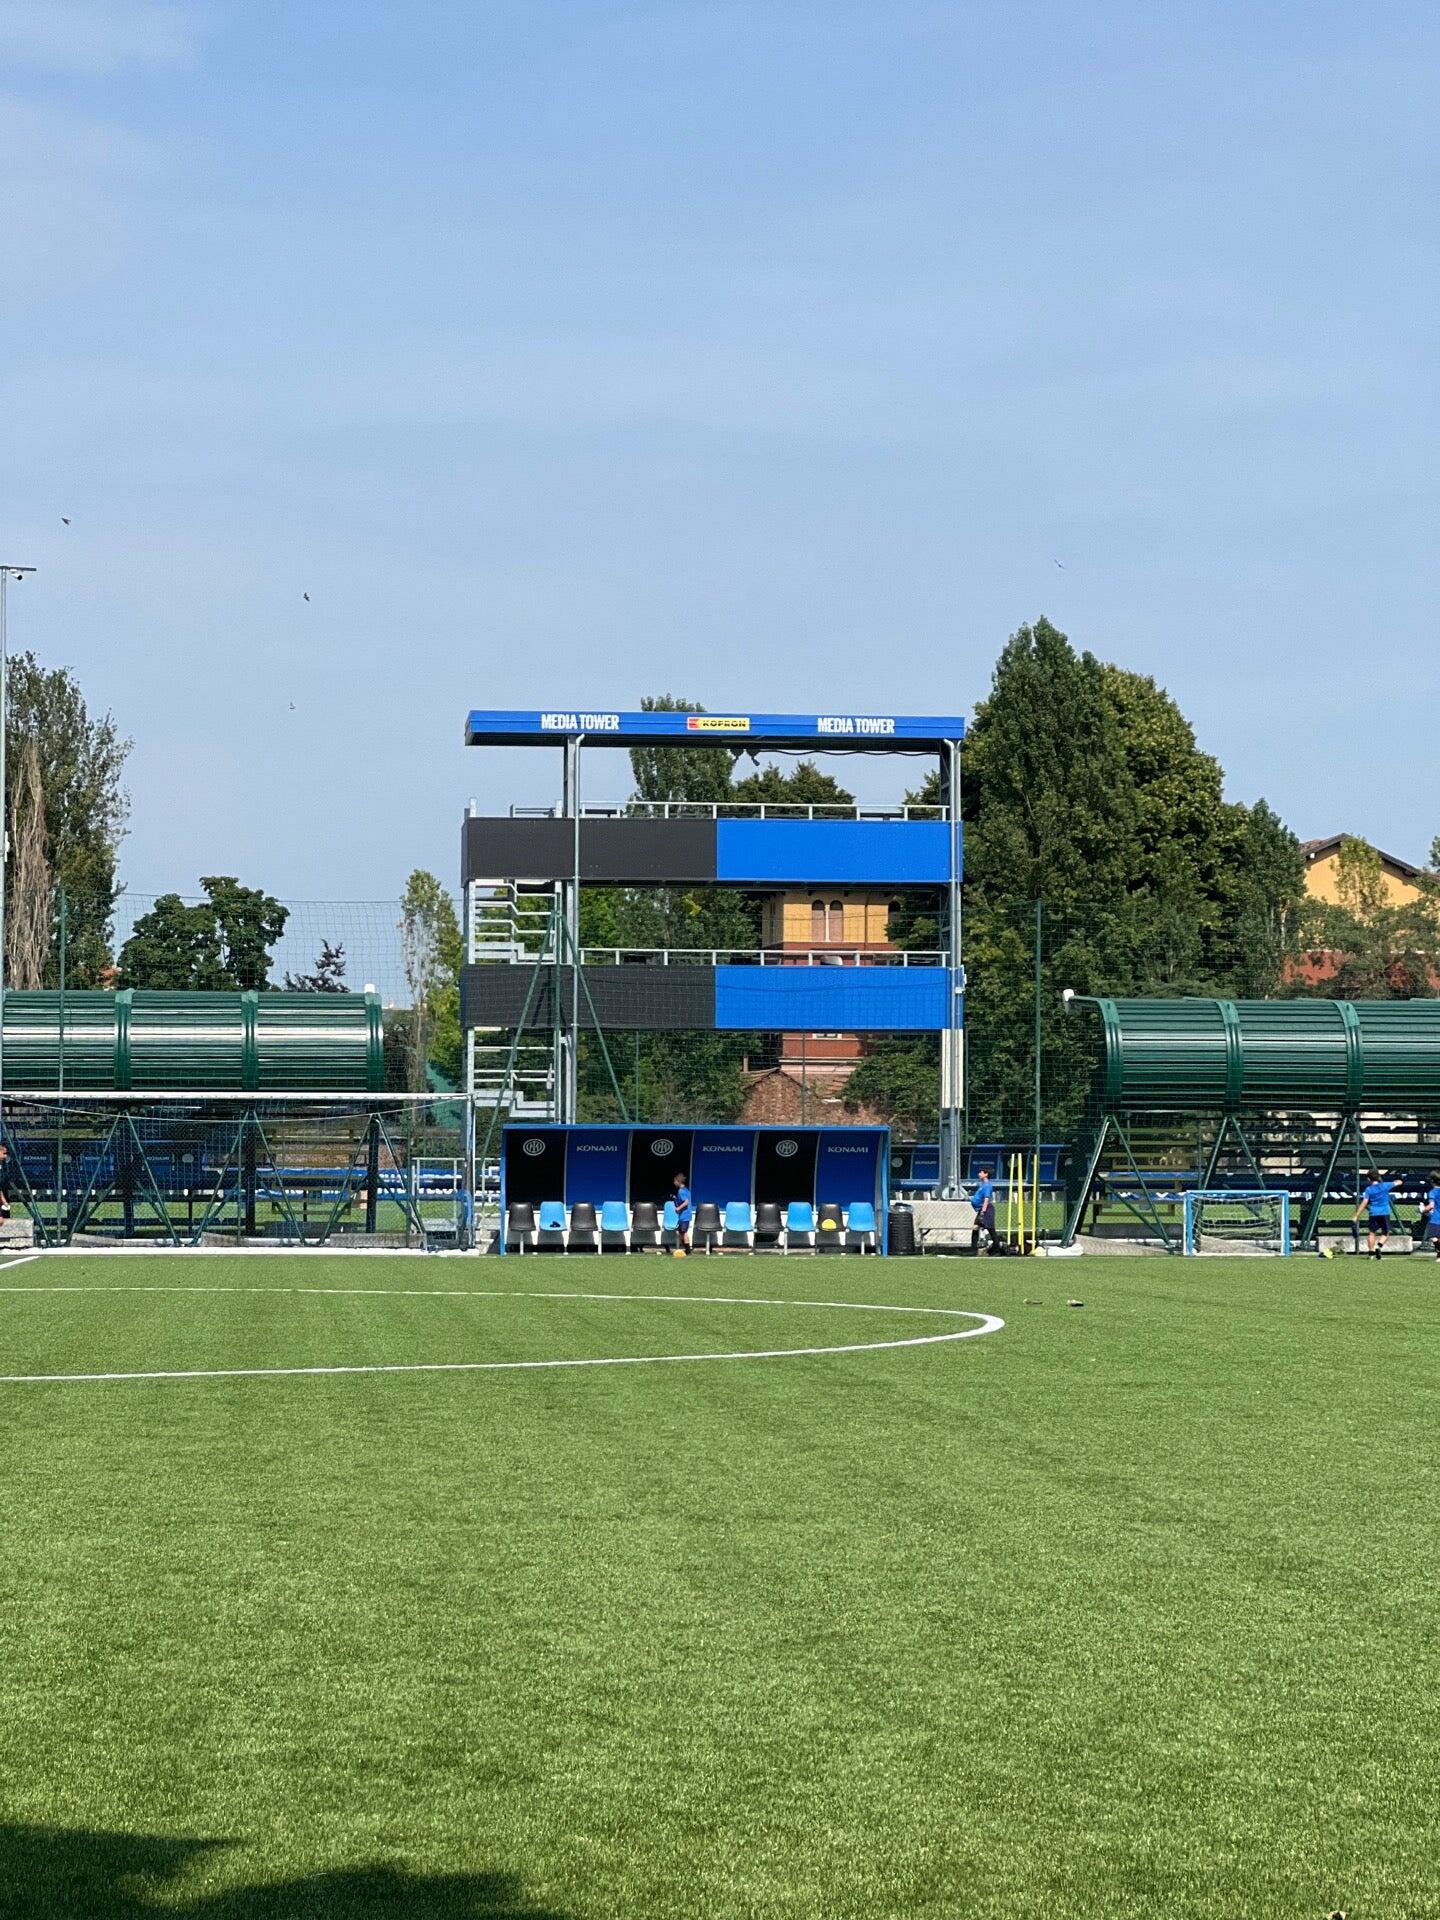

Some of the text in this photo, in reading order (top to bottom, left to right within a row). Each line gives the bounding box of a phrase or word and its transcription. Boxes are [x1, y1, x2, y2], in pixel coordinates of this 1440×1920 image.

[541, 713, 620, 730] MEDIA TOWER
[817, 717, 895, 734] MEDIA TOWER
[576, 1144, 618, 1152] KONAMI
[702, 1145, 744, 1153] KONAMI
